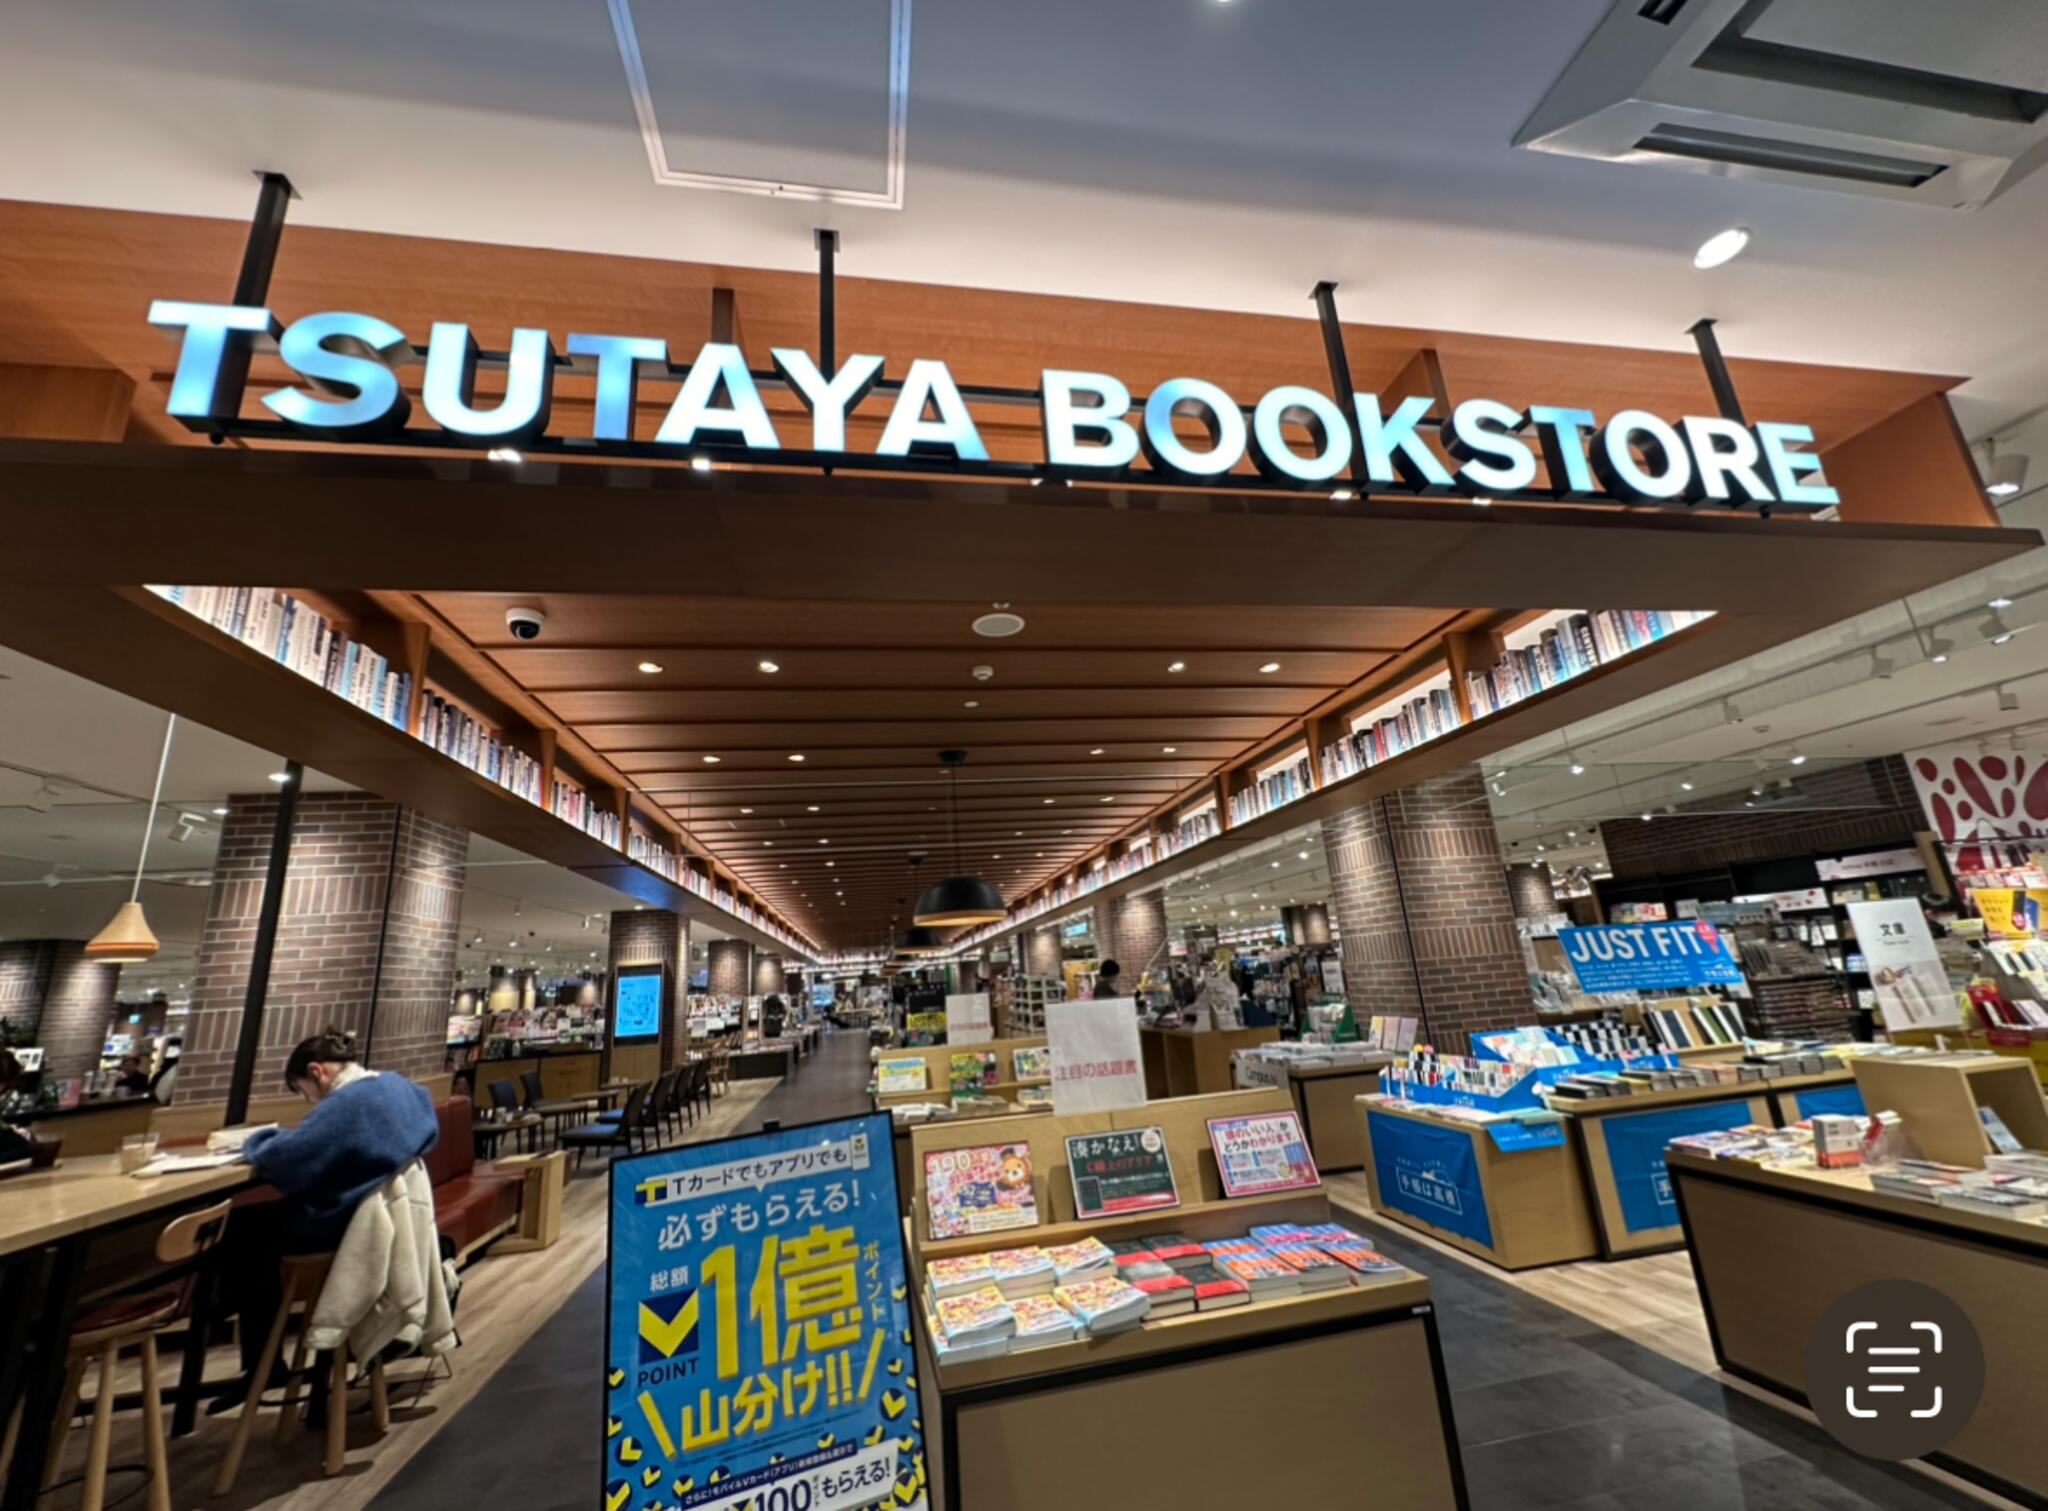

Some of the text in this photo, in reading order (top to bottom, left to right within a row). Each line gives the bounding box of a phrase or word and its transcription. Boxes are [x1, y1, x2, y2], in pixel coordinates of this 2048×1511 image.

[148, 300, 1840, 505] TSUTAYA BOOKSTORE
[1572, 929, 1650, 963] JUST
[1651, 925, 1703, 957] FIT
[1054, 1058, 1138, 1081] 注目の話題書
[672, 1147, 848, 1196] Tカードでもアプリでも
[658, 1179, 861, 1251] 必ずもらえる!
[650, 1264, 689, 1293] 総額
[701, 1224, 862, 1380] 1億
[863, 1240, 886, 1323] ポイント
[638, 1357, 700, 1388] POINT
[755, 1479, 812, 1511] 100
[821, 1457, 892, 1498] もらえる!
